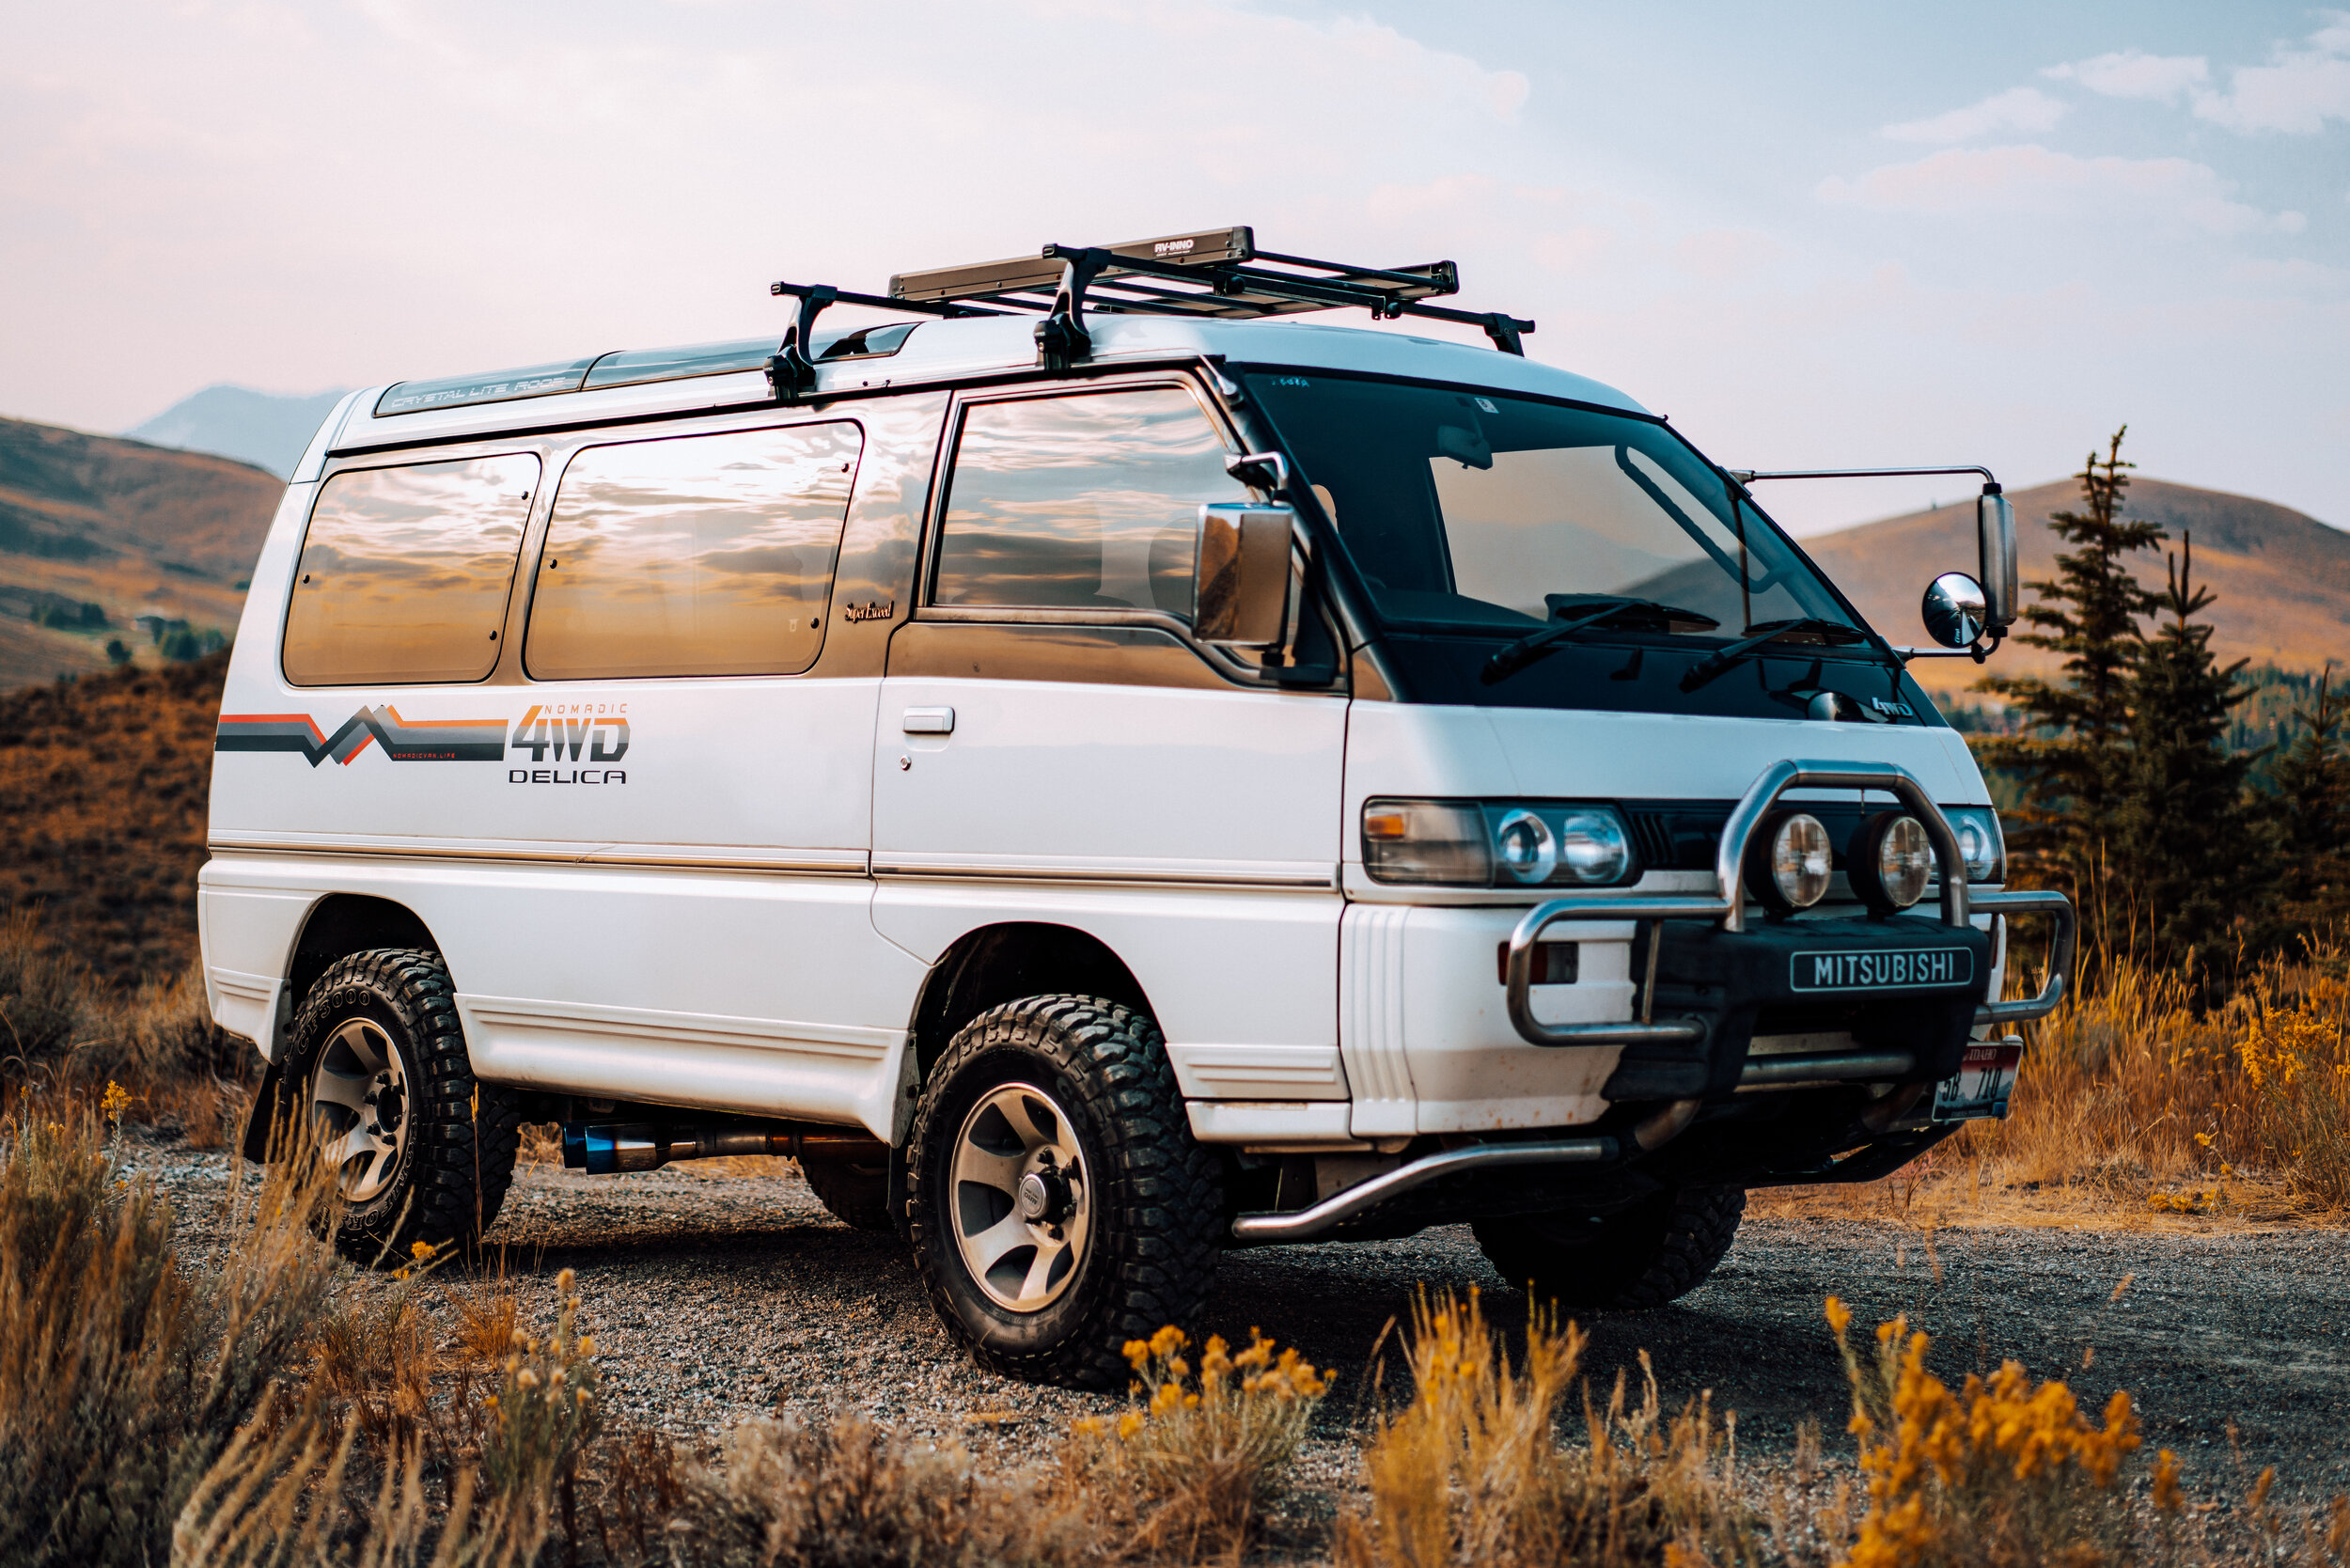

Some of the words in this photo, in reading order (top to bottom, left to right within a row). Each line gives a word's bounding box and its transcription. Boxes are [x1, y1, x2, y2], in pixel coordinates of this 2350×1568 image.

[391, 389, 465, 408] CRYSTAL
[469, 383, 509, 396] LITE
[514, 377, 566, 391] ROOF
[544, 703, 628, 714] NOMADIC
[1872, 697, 1914, 717] 4WD
[511, 705, 631, 762] 4WD
[509, 770, 626, 784] DELICA
[1814, 952, 1953, 985] MITSUBISHI
[298, 988, 370, 1056] CF3000
[1968, 1048, 1998, 1061] IDAHO
[1976, 1067, 2003, 1100] 710
